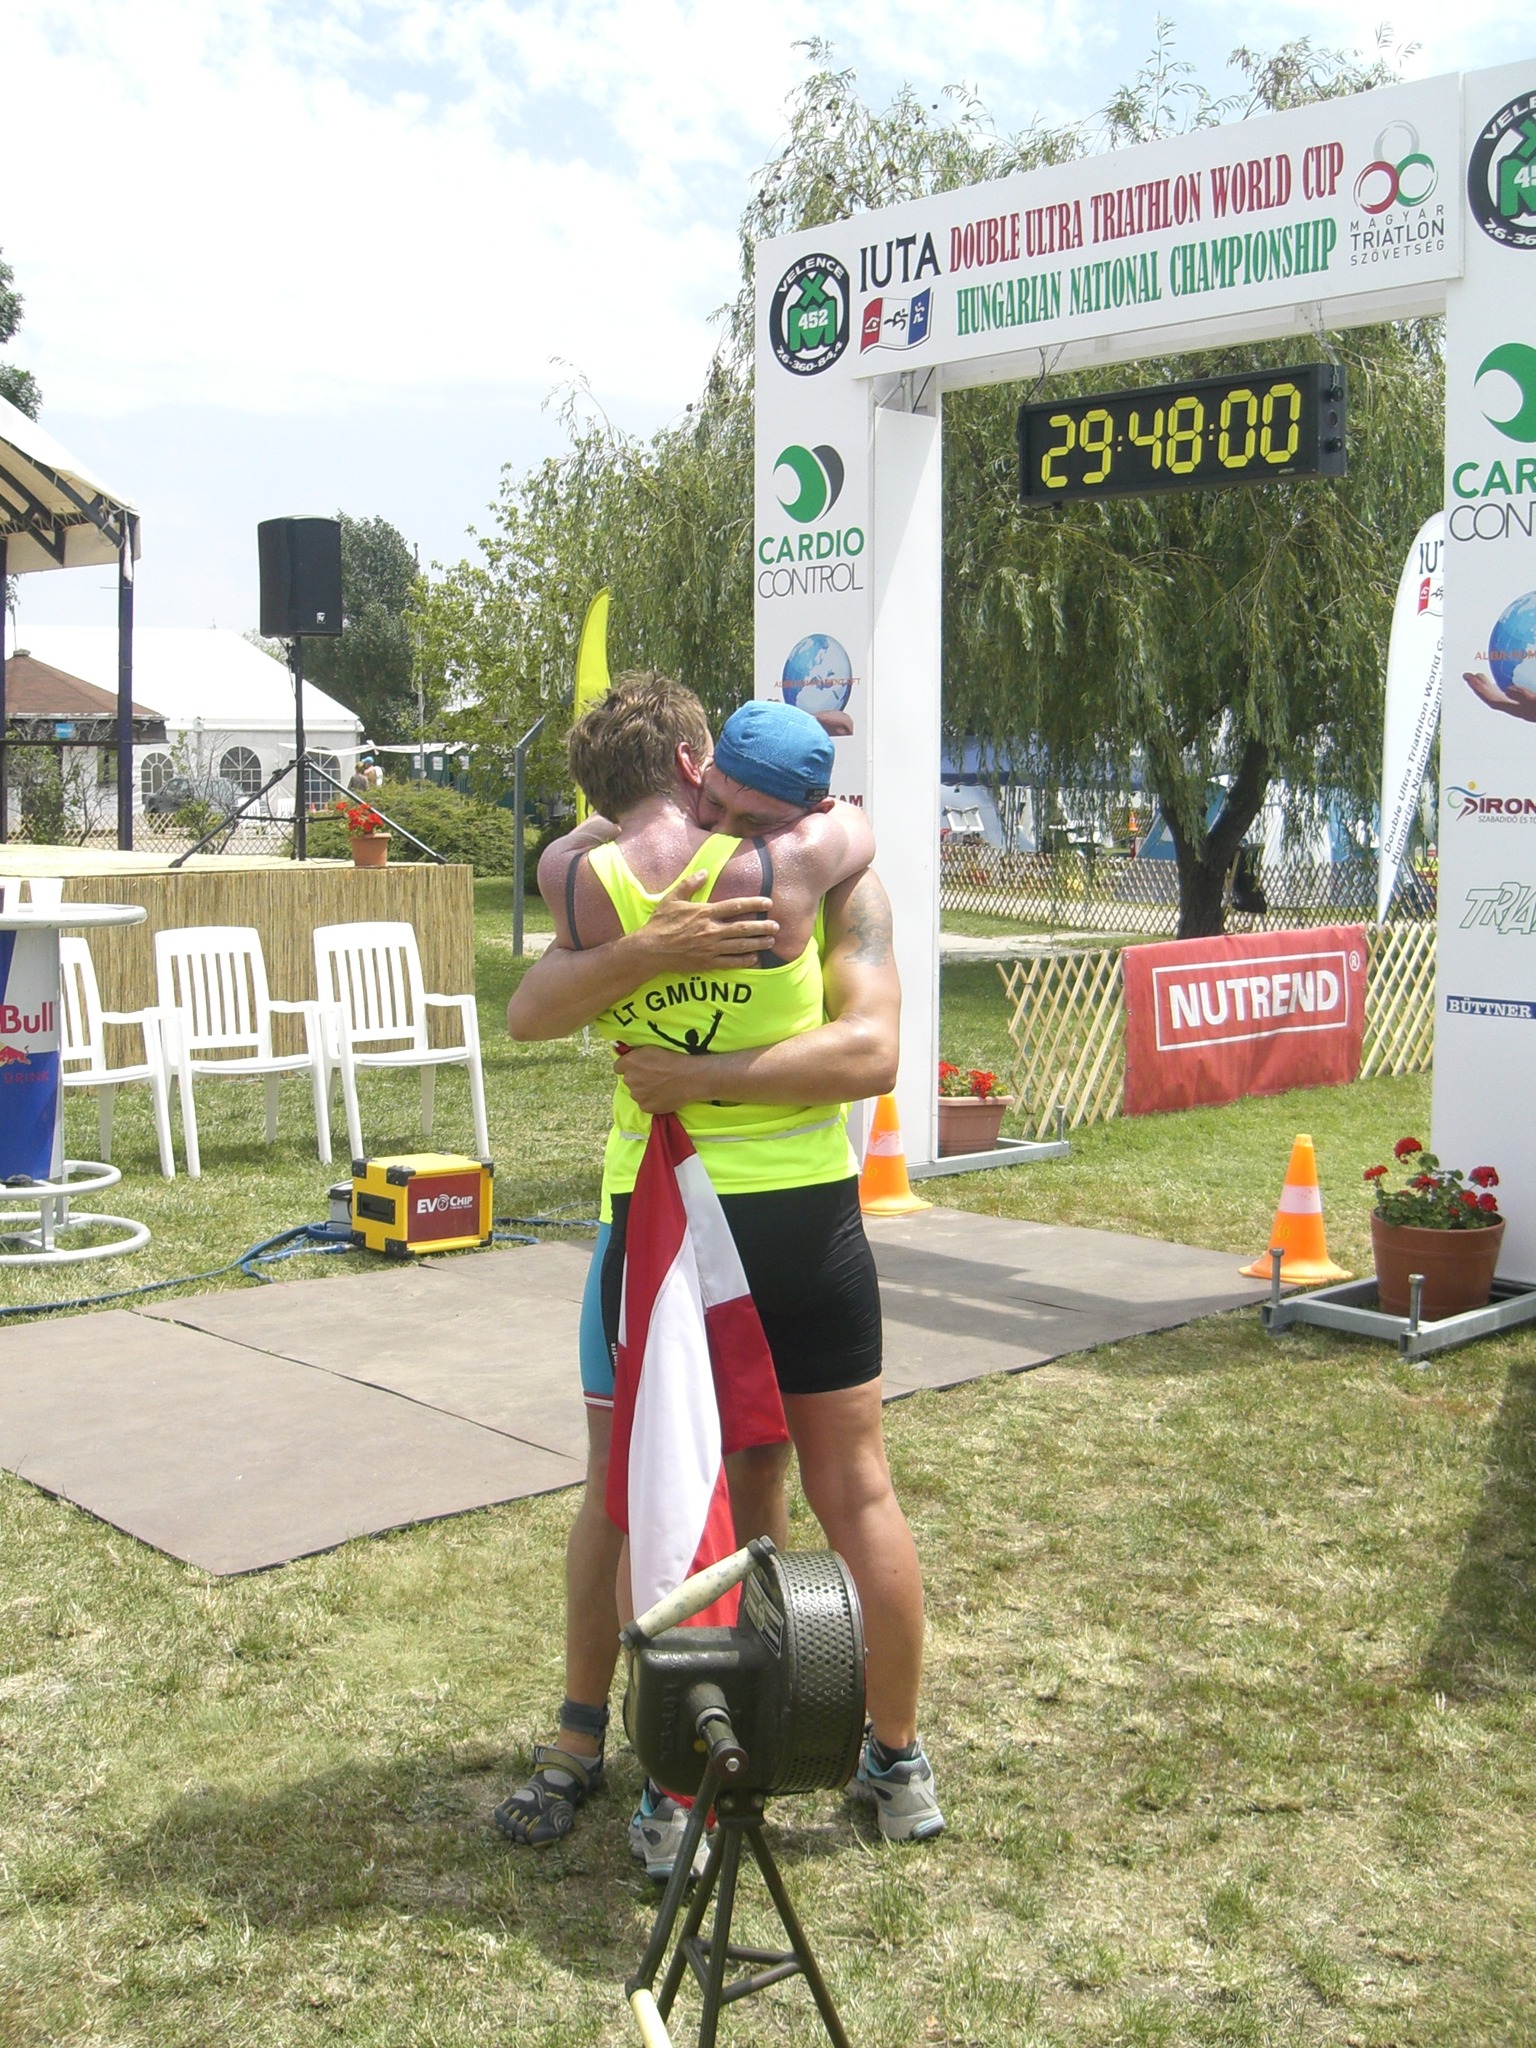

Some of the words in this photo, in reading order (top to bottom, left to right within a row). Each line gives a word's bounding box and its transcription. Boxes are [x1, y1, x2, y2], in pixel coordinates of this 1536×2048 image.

[859, 231, 941, 293] IUTA
[950, 213, 1020, 273] DOUBLE
[1025, 199, 1083, 258] ULTRA
[1090, 171, 1202, 245] TRIATHLON
[1210, 153, 1292, 220] WORLD
[1302, 141, 1344, 201] CUP
[1350, 204, 1444, 232] MAGYAR
[1350, 218, 1444, 252] TRIATLON
[1350, 238, 1445, 266] SZÖVETSÉG
[778, 256, 844, 293] VELENCE
[956, 270, 1062, 337] HUNGARIAN
[1069, 250, 1162, 316] NATIONAL
[1169, 217, 1337, 297] CHAMPIONSHIP
[798, 309, 828, 330] 452
[1041, 382, 1301, 489] 29:48:00
[1452, 457, 1536, 499] CAR
[1449, 500, 1536, 542] CON
[758, 527, 865, 565] CARDIO
[758, 562, 864, 598] CONTROL
[1384, 805, 1402, 854] Double
[1398, 768, 1412, 801] Ultra
[1407, 702, 1428, 764] Triathlon
[1424, 654, 1441, 697] World
[1391, 794, 1416, 866] Hungarian
[1411, 731, 1432, 791] National
[0, 1001, 54, 1034] Bull
[613, 1001, 640, 1027] LT
[645, 976, 753, 1012] GMÜND
[1168, 969, 1340, 1030] NUTREND
[1448, 997, 1532, 1018] BÜTTNER
